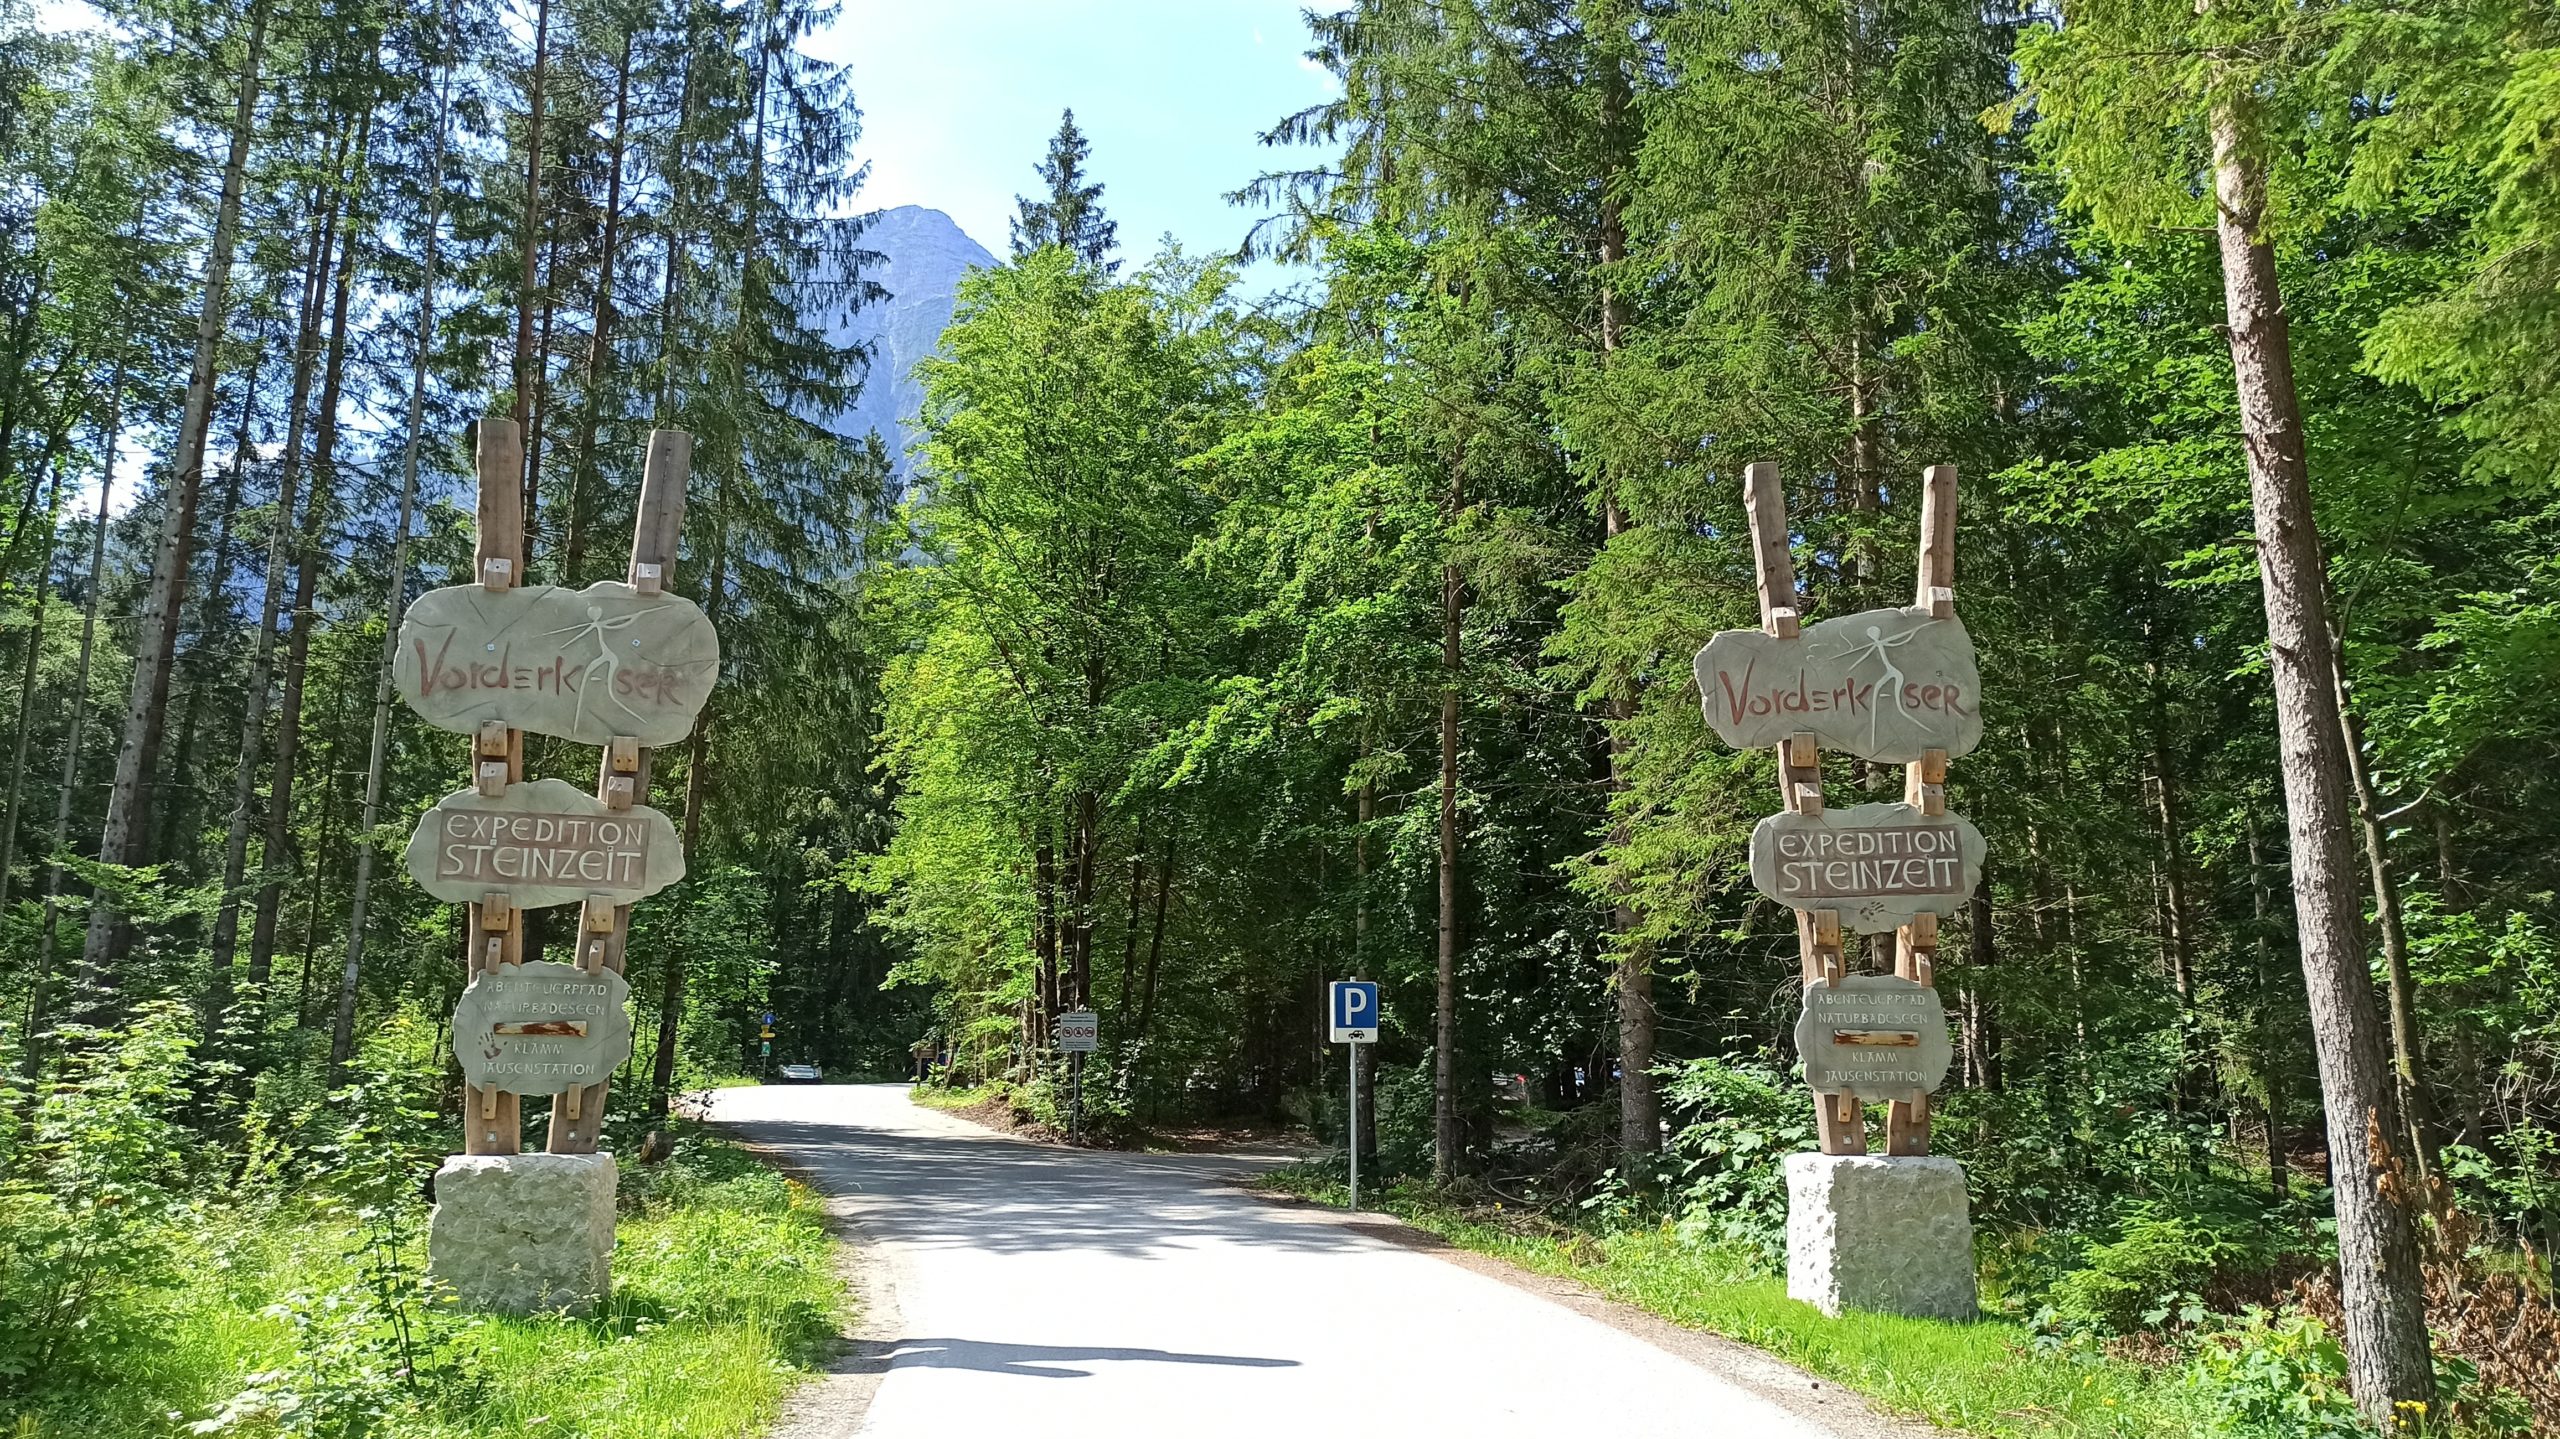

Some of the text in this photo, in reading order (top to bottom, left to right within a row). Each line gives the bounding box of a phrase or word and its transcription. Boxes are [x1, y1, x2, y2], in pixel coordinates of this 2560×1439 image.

[446, 814, 643, 847] EXPEDITION
[1779, 830, 1956, 857] EXPEDITION
[440, 843, 642, 883] STEINZEIT
[1782, 857, 1959, 892] STEINZEIT
[1344, 987, 1368, 1026] P
[481, 1061, 595, 1076] JAUSENSTATION
[1852, 1051, 1898, 1064] KLAMM
[1825, 1070, 1928, 1083] JAUSENSTATION
